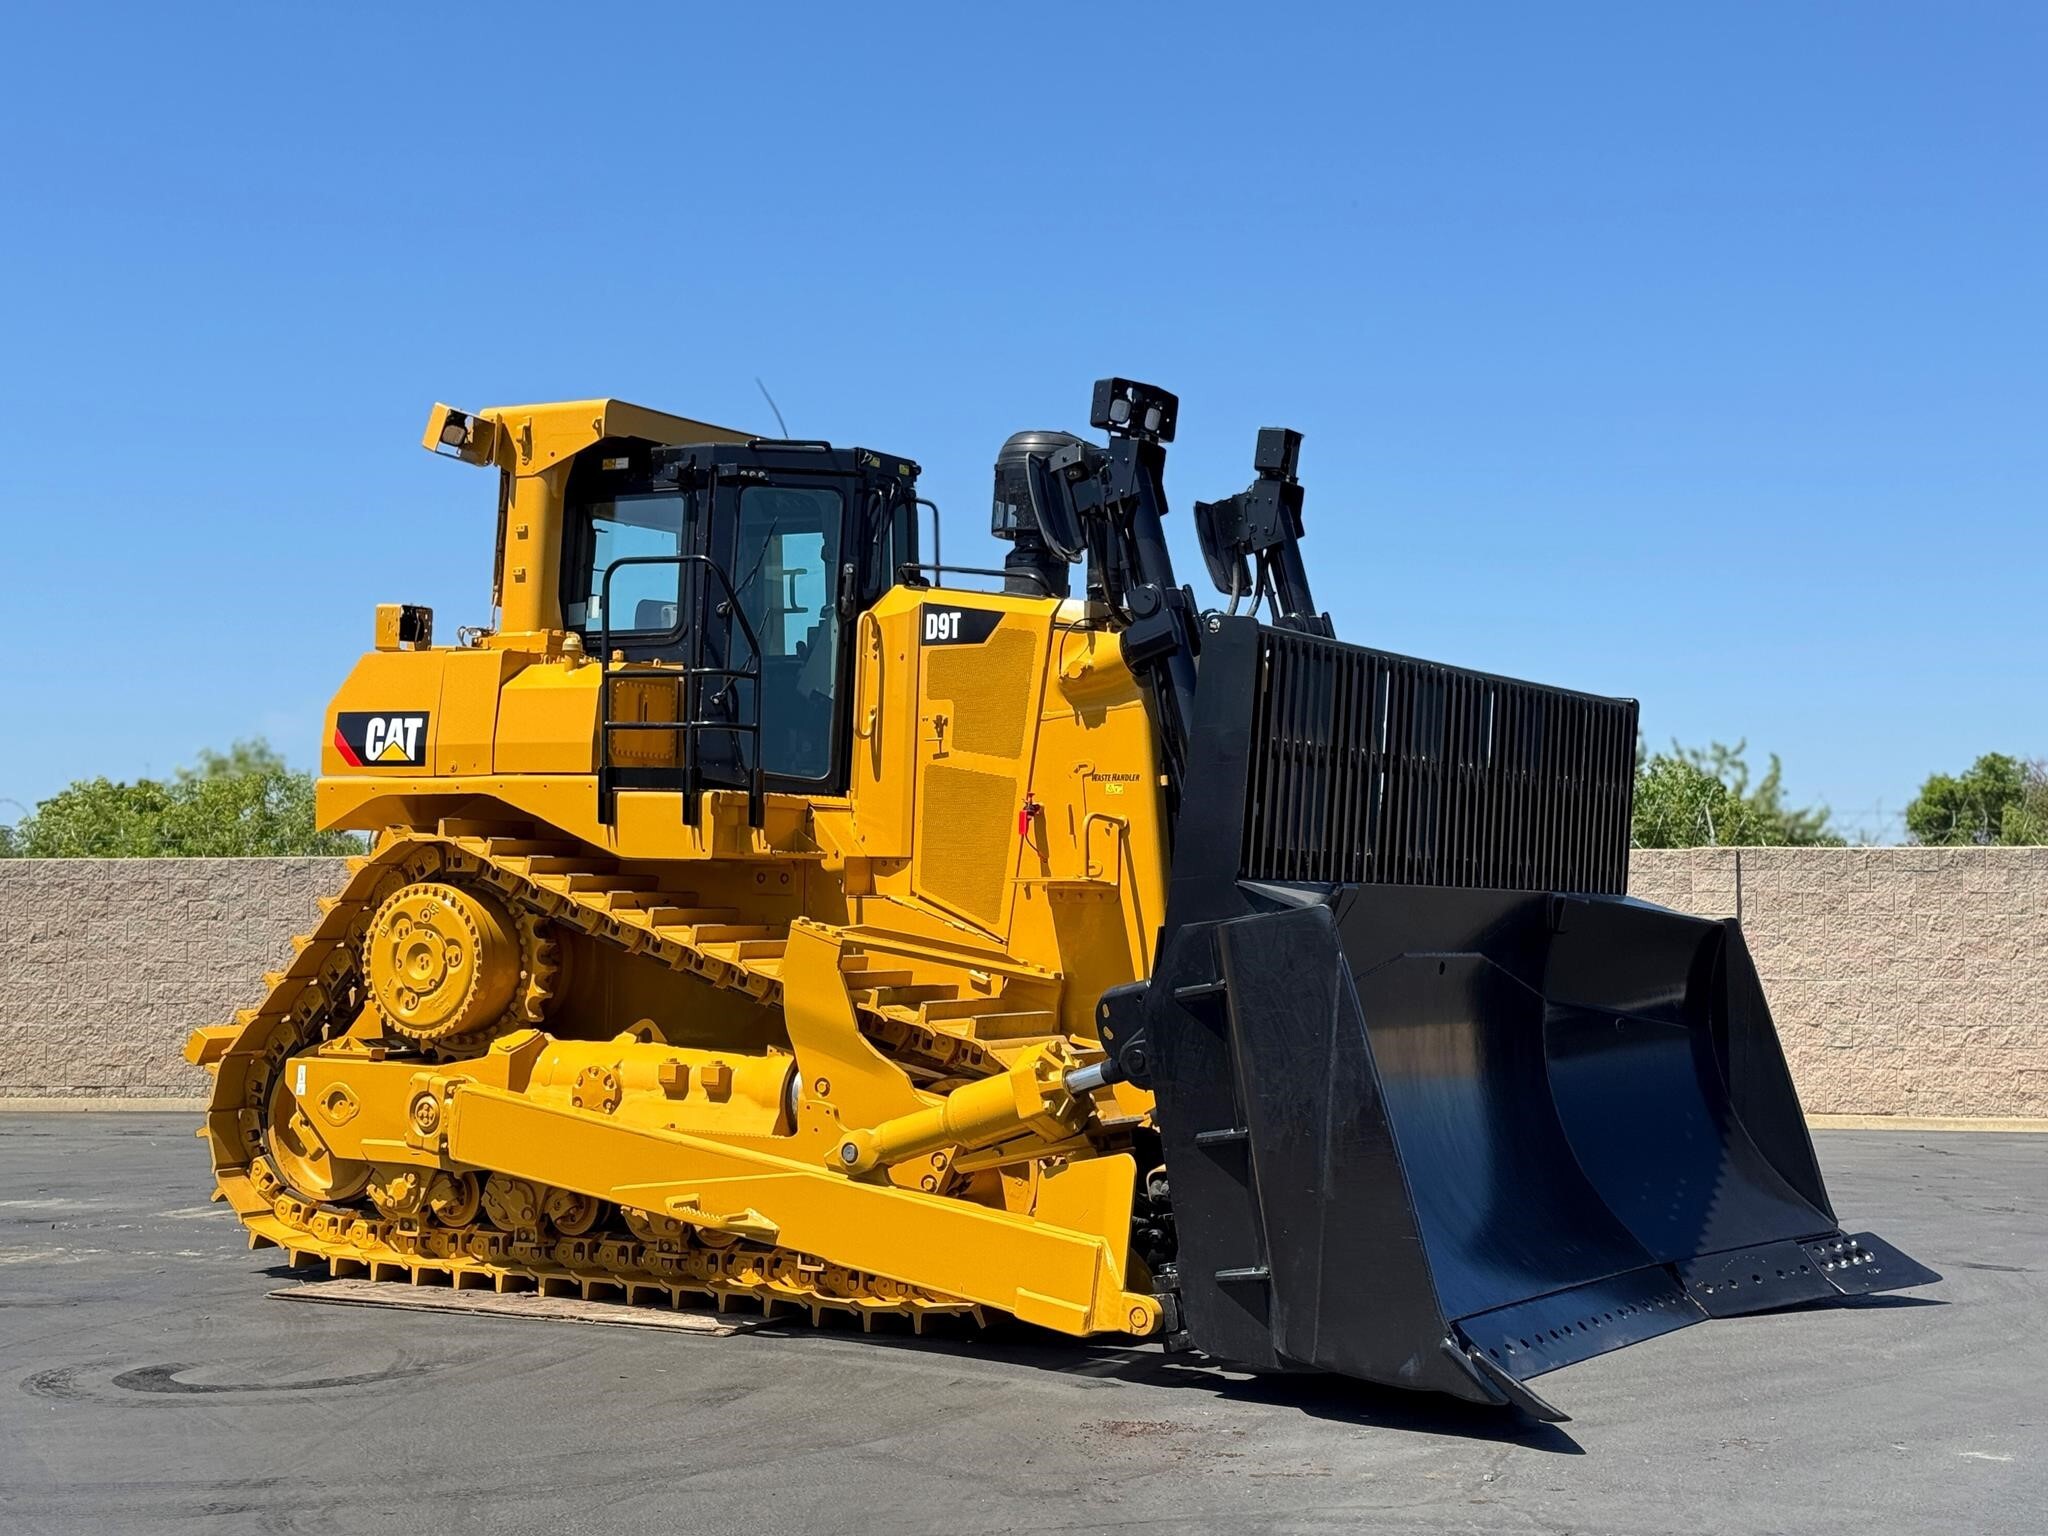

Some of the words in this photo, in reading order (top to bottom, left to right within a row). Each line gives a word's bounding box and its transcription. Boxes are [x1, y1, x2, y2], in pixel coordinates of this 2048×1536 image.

[925, 612, 961, 640] D9T
[365, 717, 423, 761] CAT
[1092, 773, 1111, 782] WASTE
[1112, 773, 1140, 782] HANDLER
